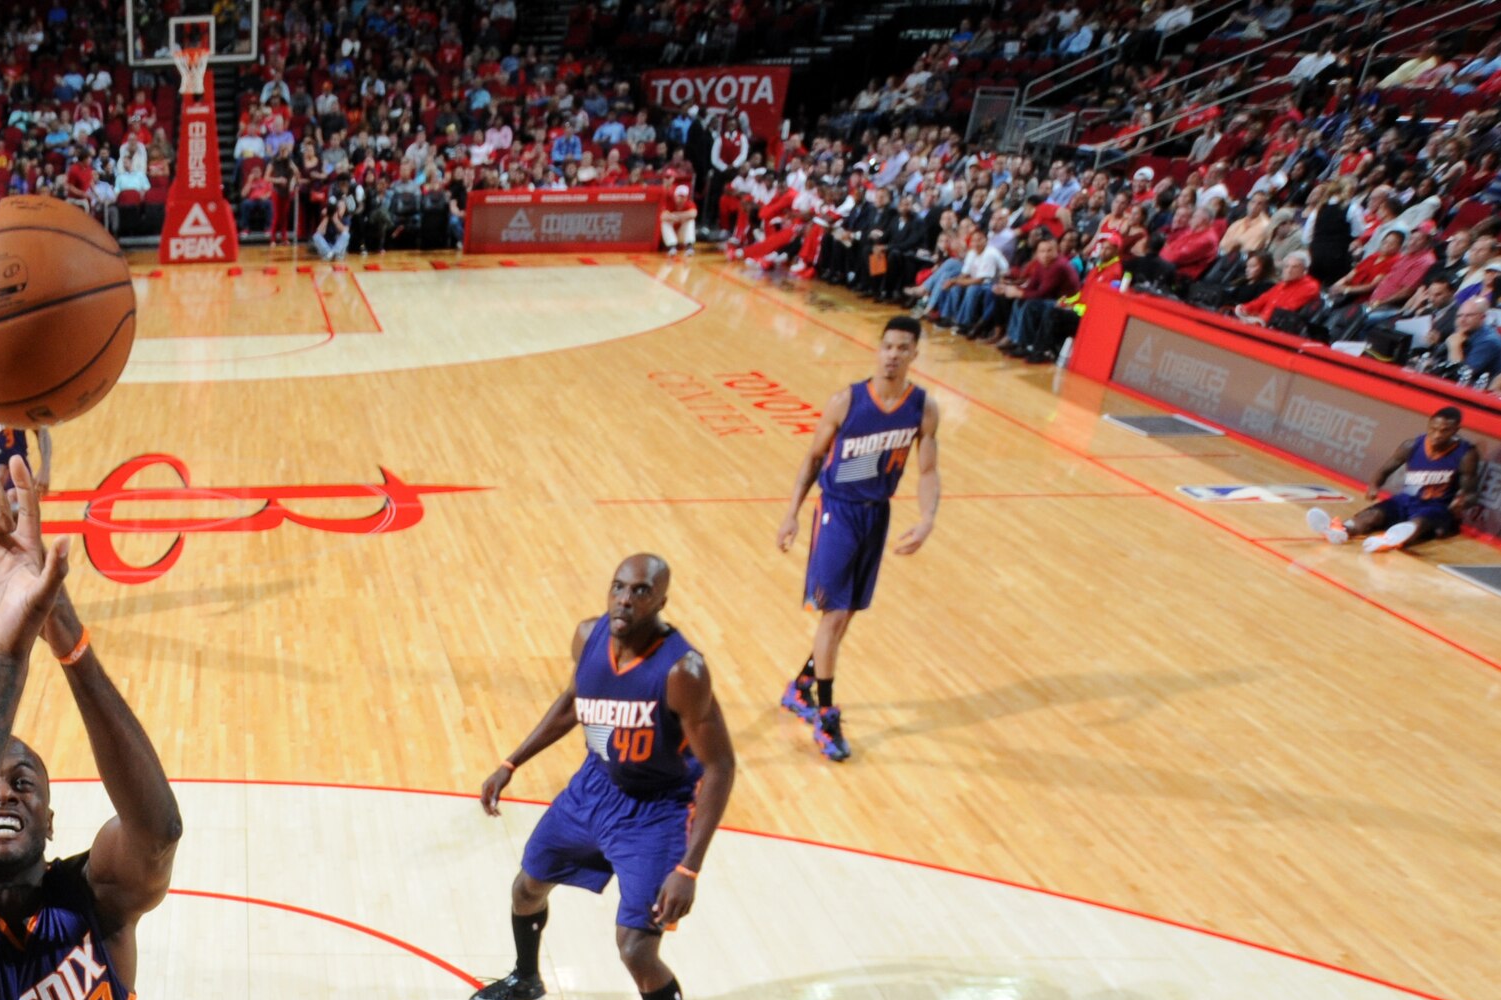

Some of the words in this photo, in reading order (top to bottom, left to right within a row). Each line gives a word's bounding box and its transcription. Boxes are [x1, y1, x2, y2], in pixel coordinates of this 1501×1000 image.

[651, 75, 775, 105] TOYOTA
[169, 235, 226, 261] PEAK
[712, 370, 822, 435] TOYOTA
[841, 426, 919, 460] PHOENIX
[575, 696, 657, 728] PHOENIX
[612, 728, 655, 763] 40
